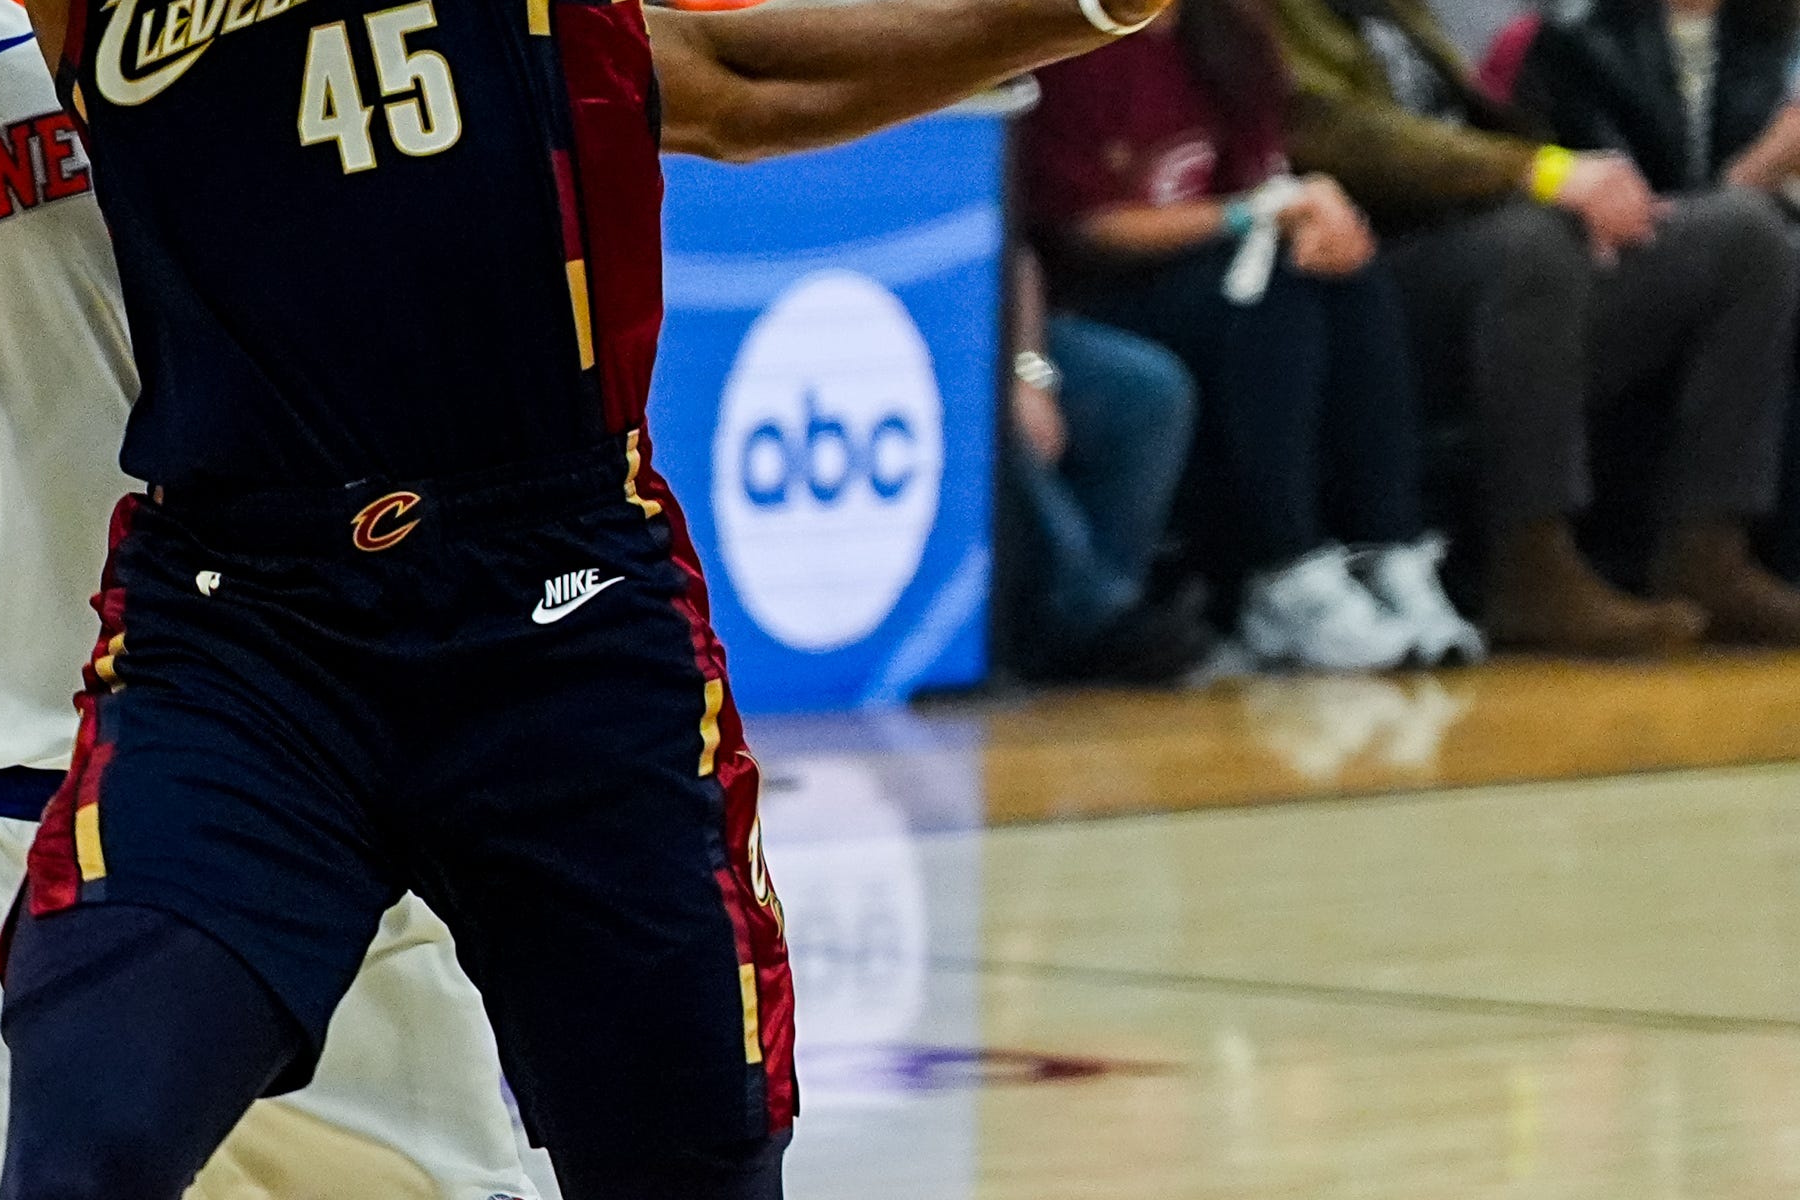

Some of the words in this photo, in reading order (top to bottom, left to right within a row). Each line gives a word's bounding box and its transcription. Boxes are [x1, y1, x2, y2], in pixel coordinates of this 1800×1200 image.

[299, 0, 463, 175] 45
[744, 386, 918, 506] abc
[544, 567, 601, 608] NIKE
